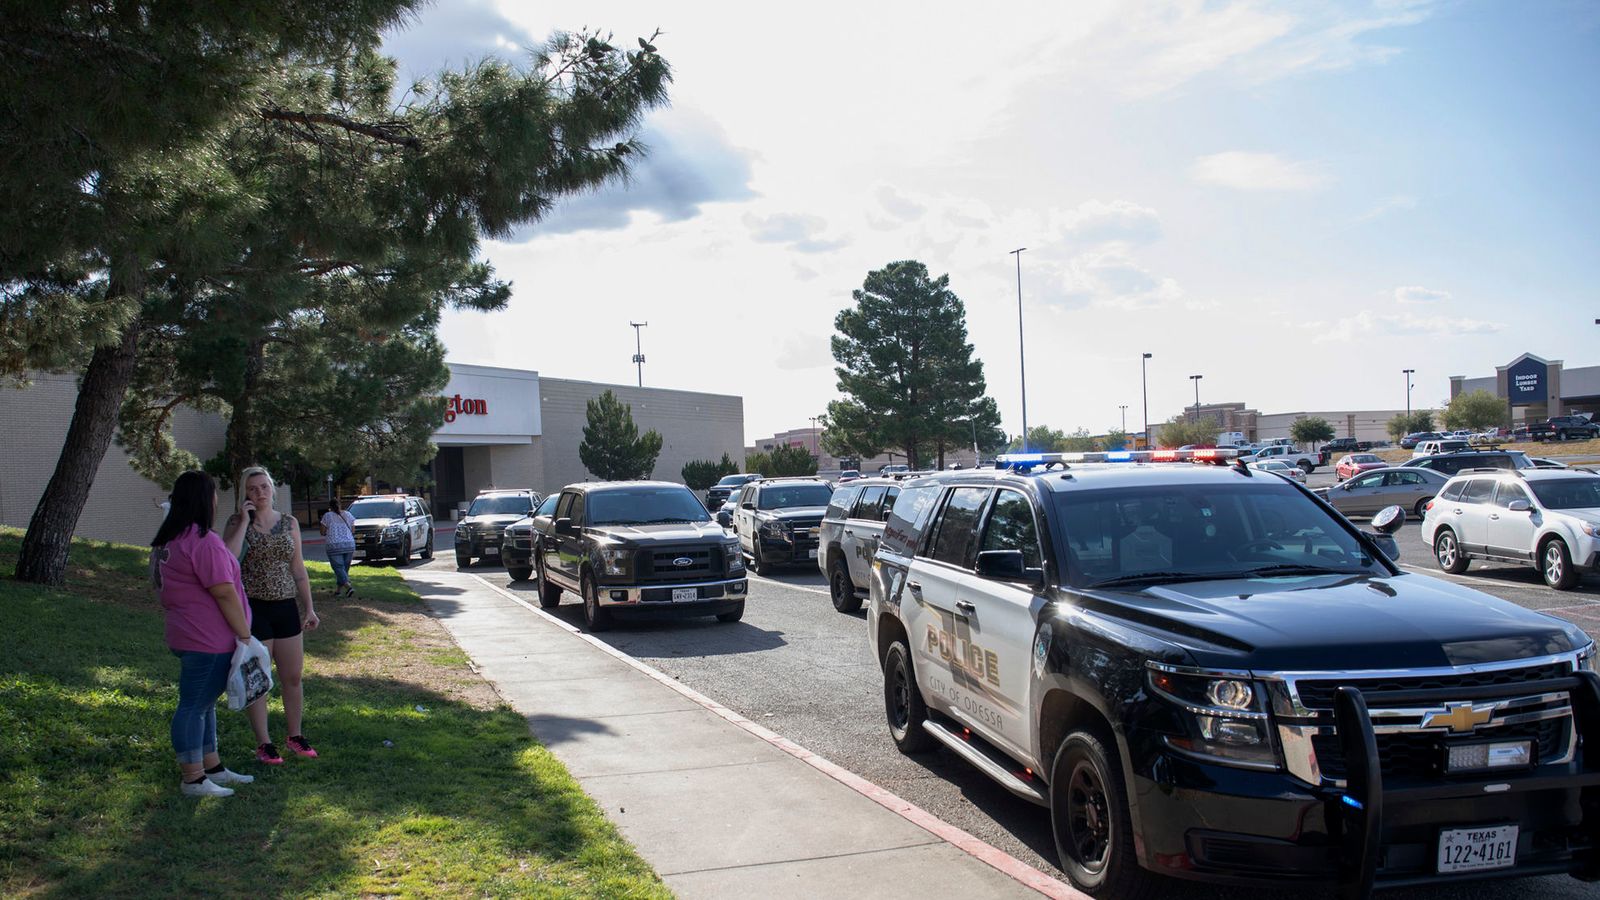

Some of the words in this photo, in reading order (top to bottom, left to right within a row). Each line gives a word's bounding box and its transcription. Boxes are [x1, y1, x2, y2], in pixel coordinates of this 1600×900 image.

[444, 394, 488, 422] gton
[927, 624, 1000, 688] POLICE
[930, 676, 946, 693] CITY
[949, 688, 960, 704] OF
[964, 696, 1003, 730] ODESSA
[1467, 831, 1496, 840] TEXAS
